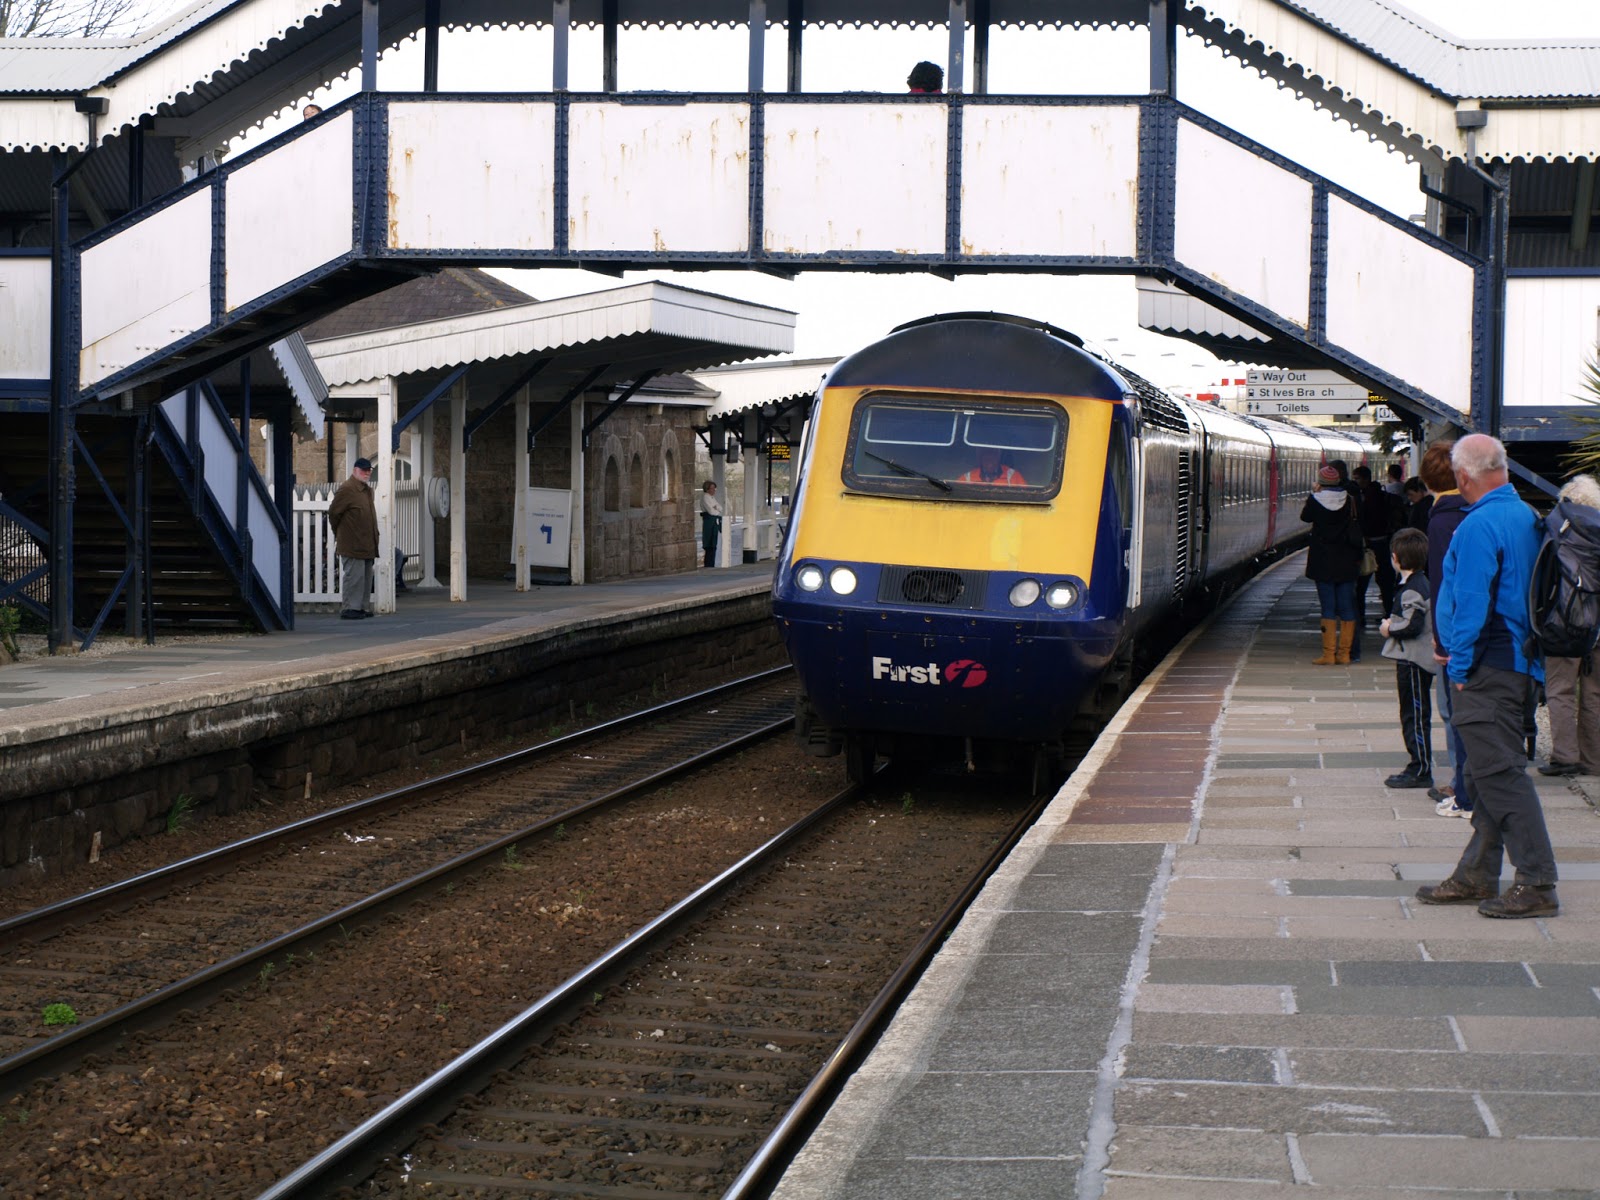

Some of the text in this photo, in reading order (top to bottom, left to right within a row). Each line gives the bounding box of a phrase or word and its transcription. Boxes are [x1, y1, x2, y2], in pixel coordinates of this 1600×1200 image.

[1262, 372, 1306, 383] Way Out
[1259, 388, 1335, 397] St Ives Brach
[1276, 403, 1310, 412] Toilets
[872, 656, 940, 685] First
